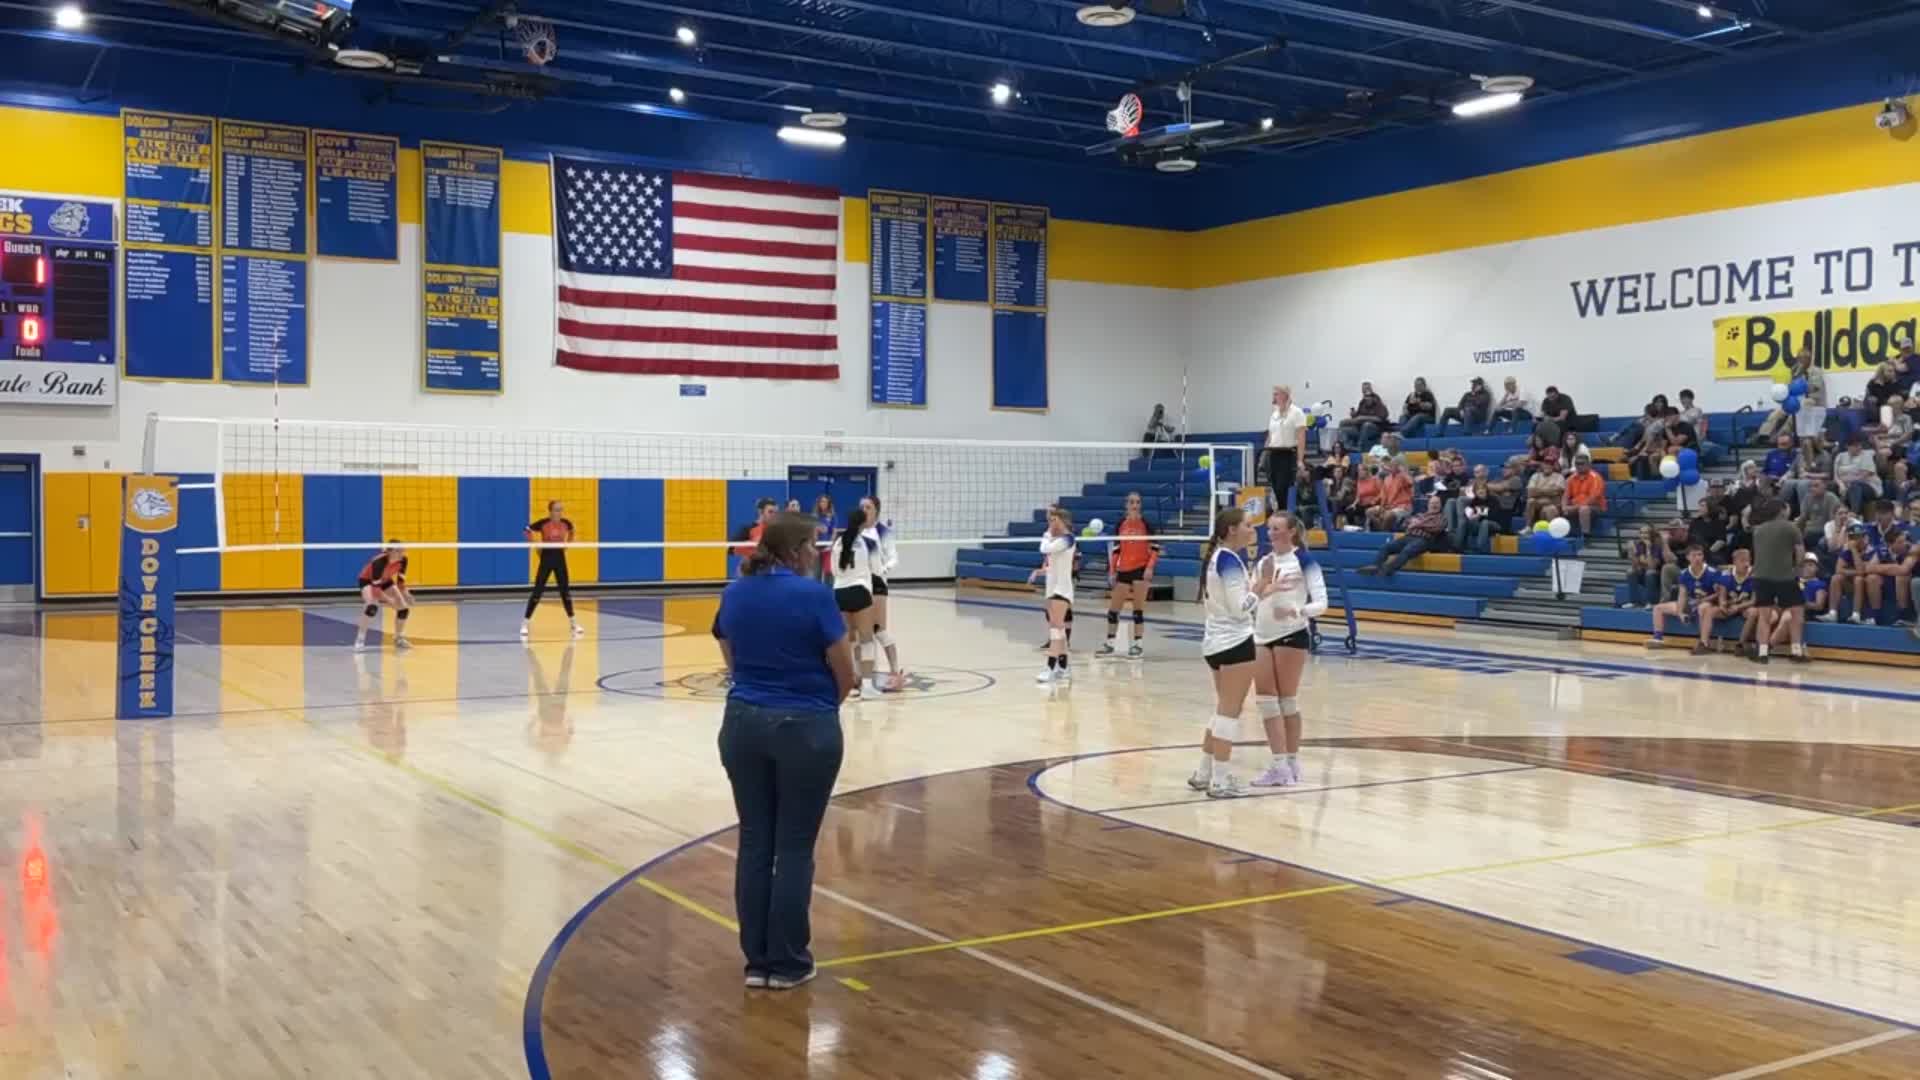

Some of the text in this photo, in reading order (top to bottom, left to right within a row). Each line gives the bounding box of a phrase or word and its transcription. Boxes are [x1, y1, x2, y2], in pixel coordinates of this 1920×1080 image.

[4, 241, 41, 255] Guests
[37, 257, 45, 284] 1
[1570, 256, 1795, 318] WELCOME
[1814, 247, 1873, 295] TO
[23, 319, 39, 340] 0
[1472, 348, 1525, 363] VISITORS
[39, 370, 107, 396] Bank
[139, 539, 160, 708] DOVE CREEK
